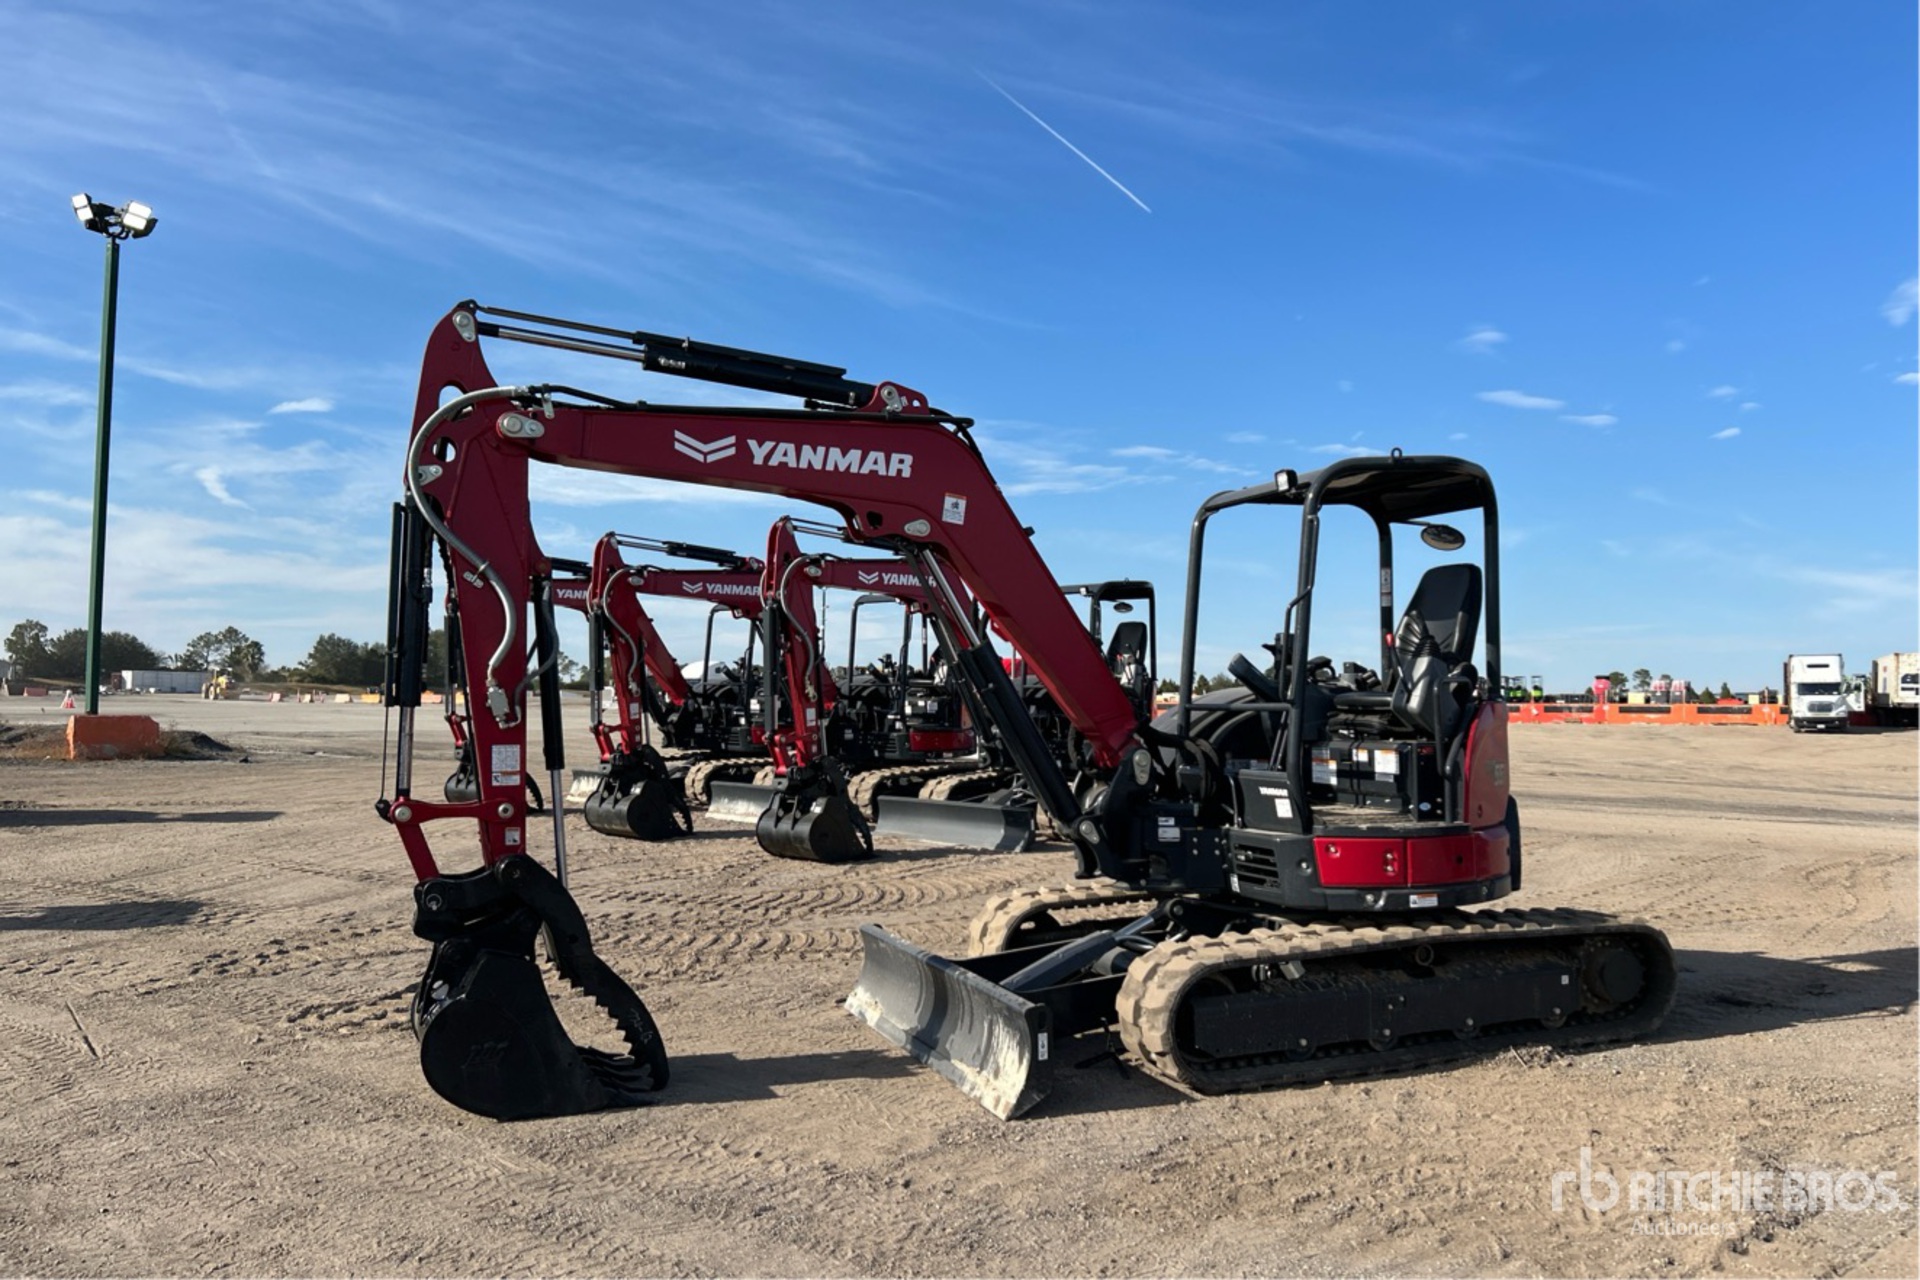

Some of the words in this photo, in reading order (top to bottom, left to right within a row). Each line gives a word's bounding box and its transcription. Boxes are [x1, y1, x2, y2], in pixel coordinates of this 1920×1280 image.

[746, 439, 914, 478] YANMAR
[881, 572, 937, 588] YANMR
[705, 583, 760, 596] YANMAR
